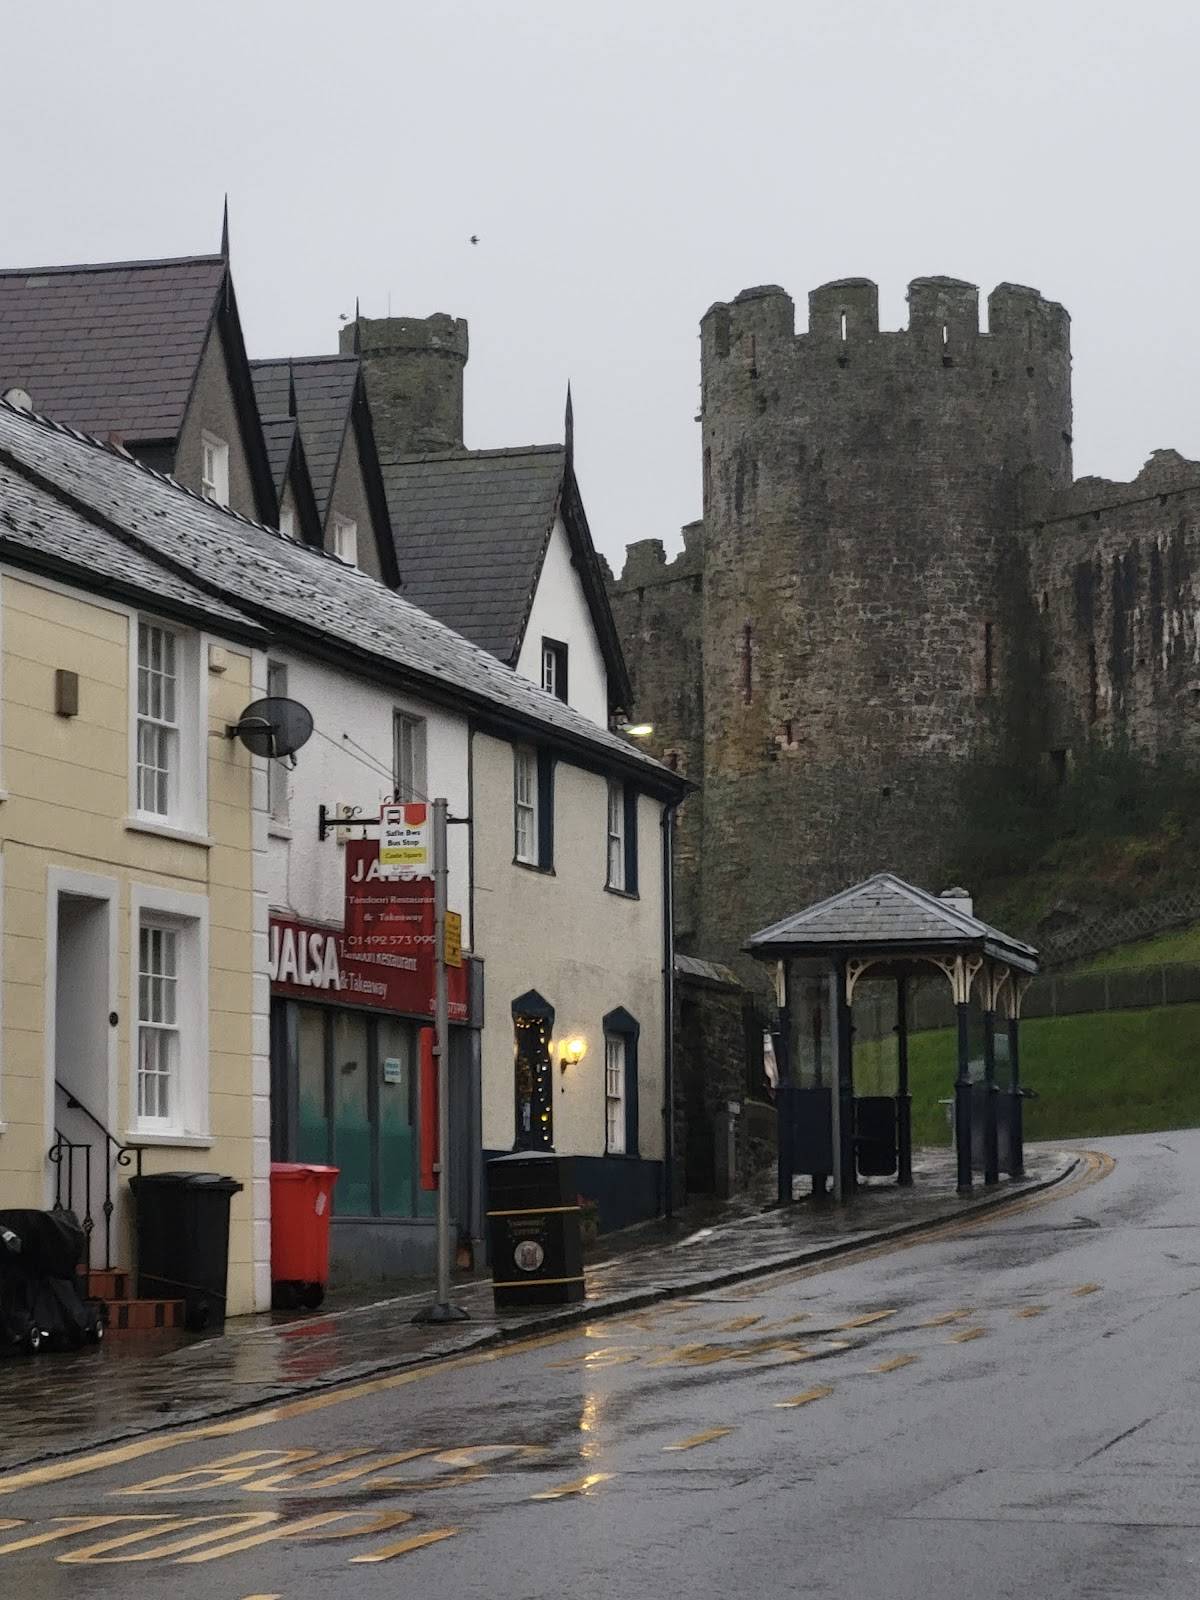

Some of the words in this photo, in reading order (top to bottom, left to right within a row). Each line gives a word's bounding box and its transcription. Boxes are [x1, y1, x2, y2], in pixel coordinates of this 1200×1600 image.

[364, 913, 373, 921] &
[266, 925, 341, 991] JALSA
[0, 1511, 414, 1564] TOP
